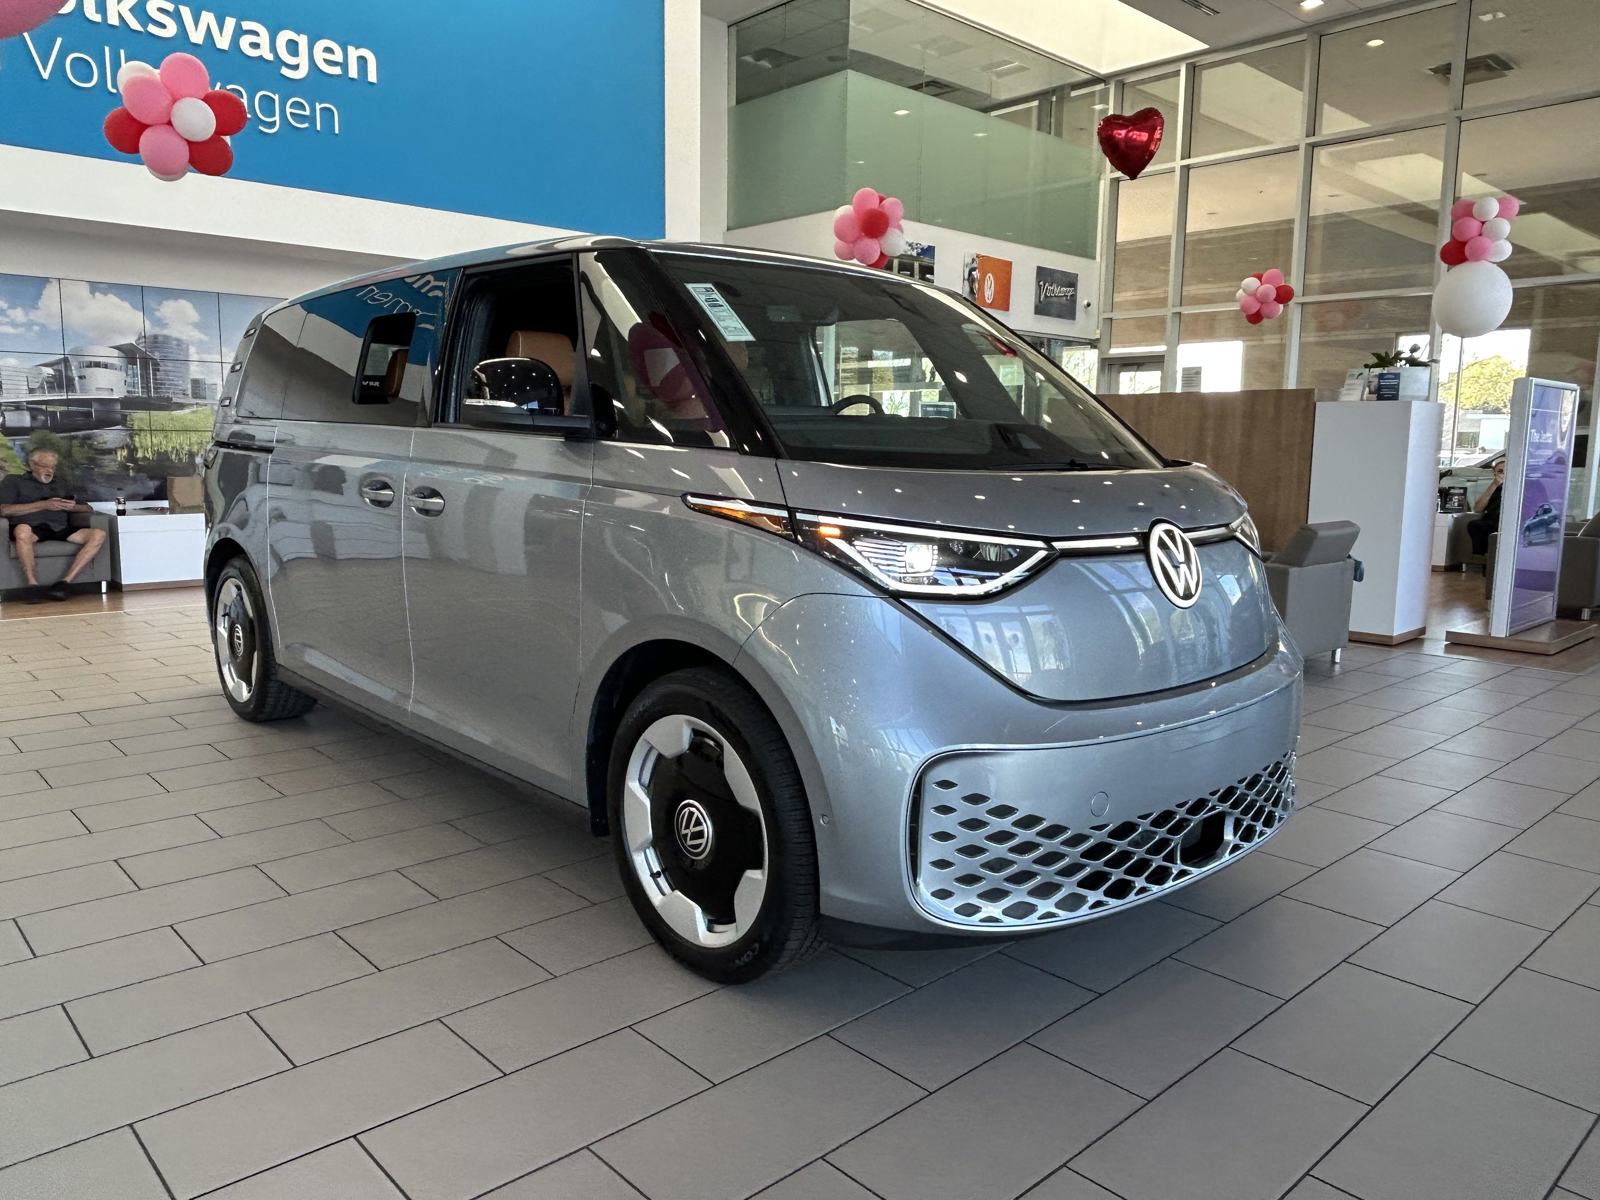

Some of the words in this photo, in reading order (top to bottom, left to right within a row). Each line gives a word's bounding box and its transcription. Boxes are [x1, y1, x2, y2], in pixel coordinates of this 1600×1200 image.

[22, 32, 339, 134] Volagen
[57, 0, 378, 84] kswagen
[1150, 523, 1203, 608] VW
[675, 799, 713, 860] VW
